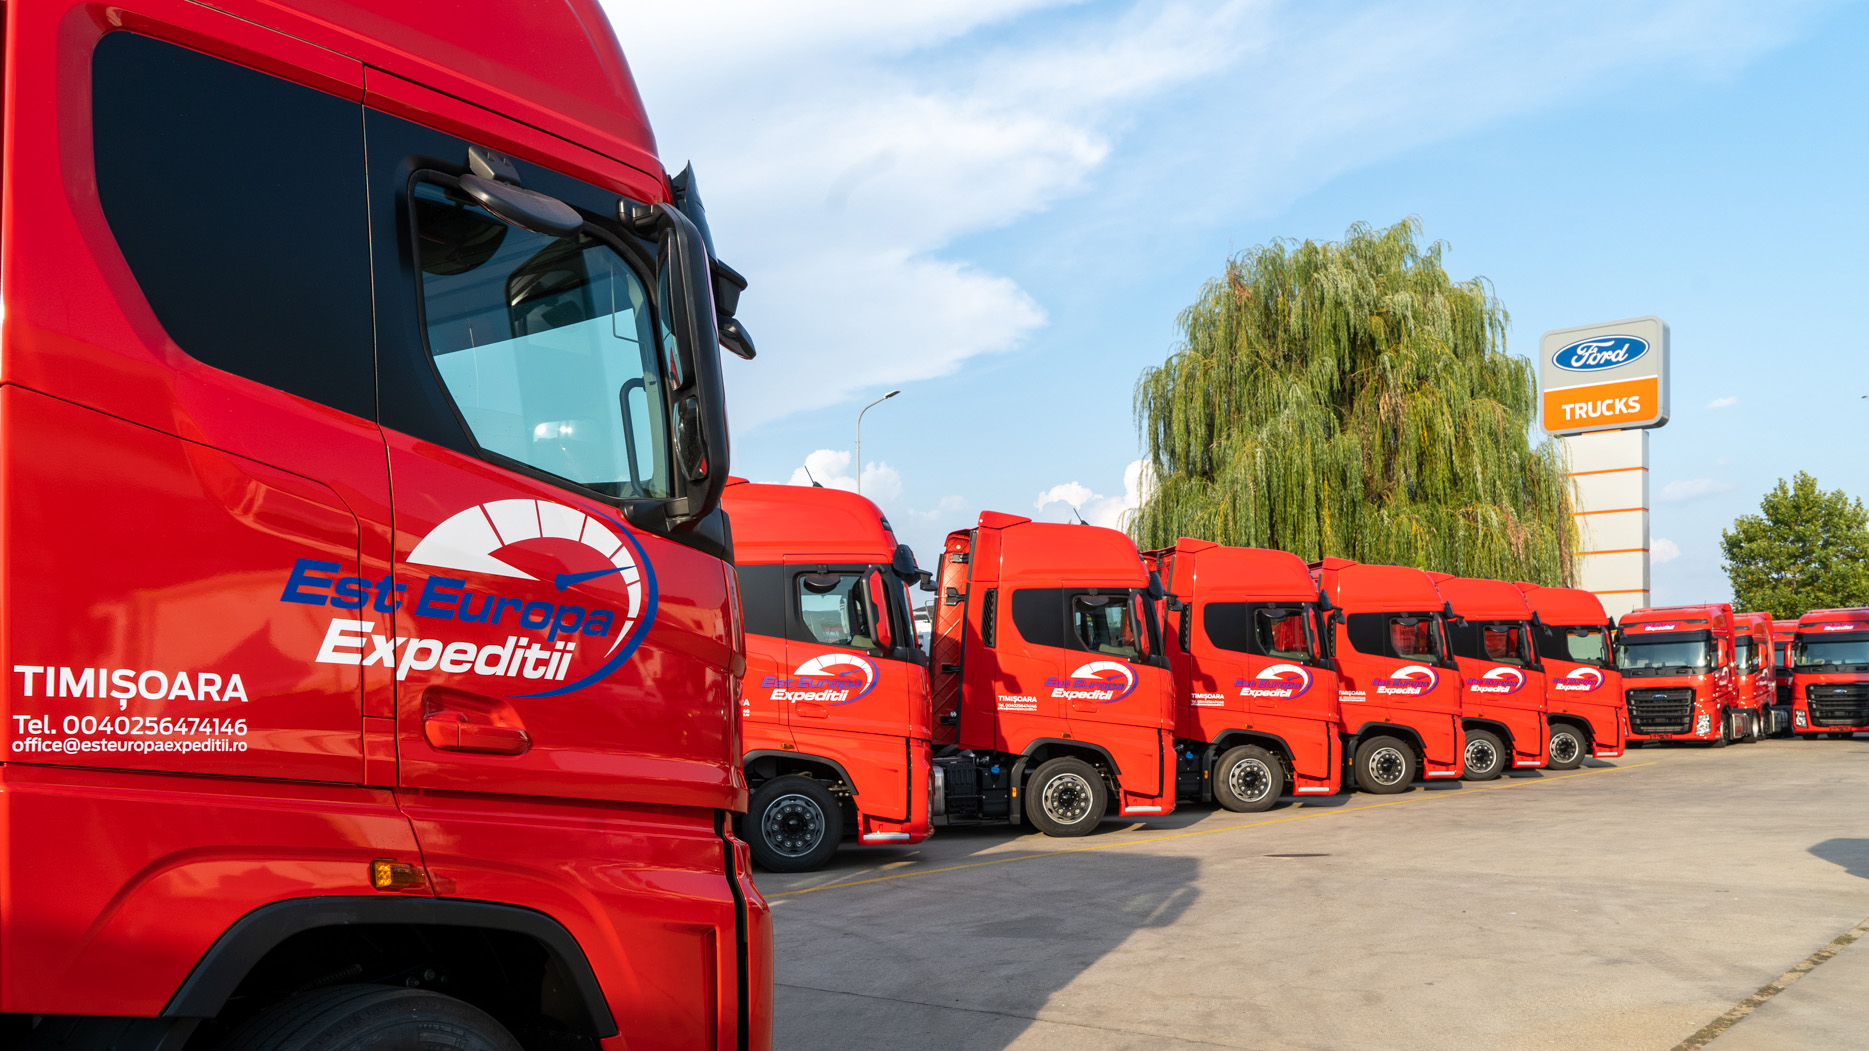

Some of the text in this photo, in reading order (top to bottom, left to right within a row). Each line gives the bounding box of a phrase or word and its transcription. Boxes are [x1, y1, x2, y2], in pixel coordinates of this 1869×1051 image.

[1571, 340, 1630, 367] Ford
[1561, 396, 1641, 421] TRUCKS
[280, 558, 615, 643] Est Europa
[315, 618, 575, 682] Expeditii
[13, 665, 249, 711] TIMIȘOARA
[761, 676, 863, 691] Est Europa
[1044, 677, 1125, 691] Est Europa
[1234, 678, 1302, 690] Est Europa
[1392, 679, 1430, 688] Europa
[770, 689, 849, 703] Expeditii
[1051, 688, 1113, 701] Expeditii
[1240, 687, 1292, 698] Expeditii
[12, 715, 249, 737] Tel. 0040256474146
[12, 738, 249, 756] office@esteuropaexpeditii.ro
